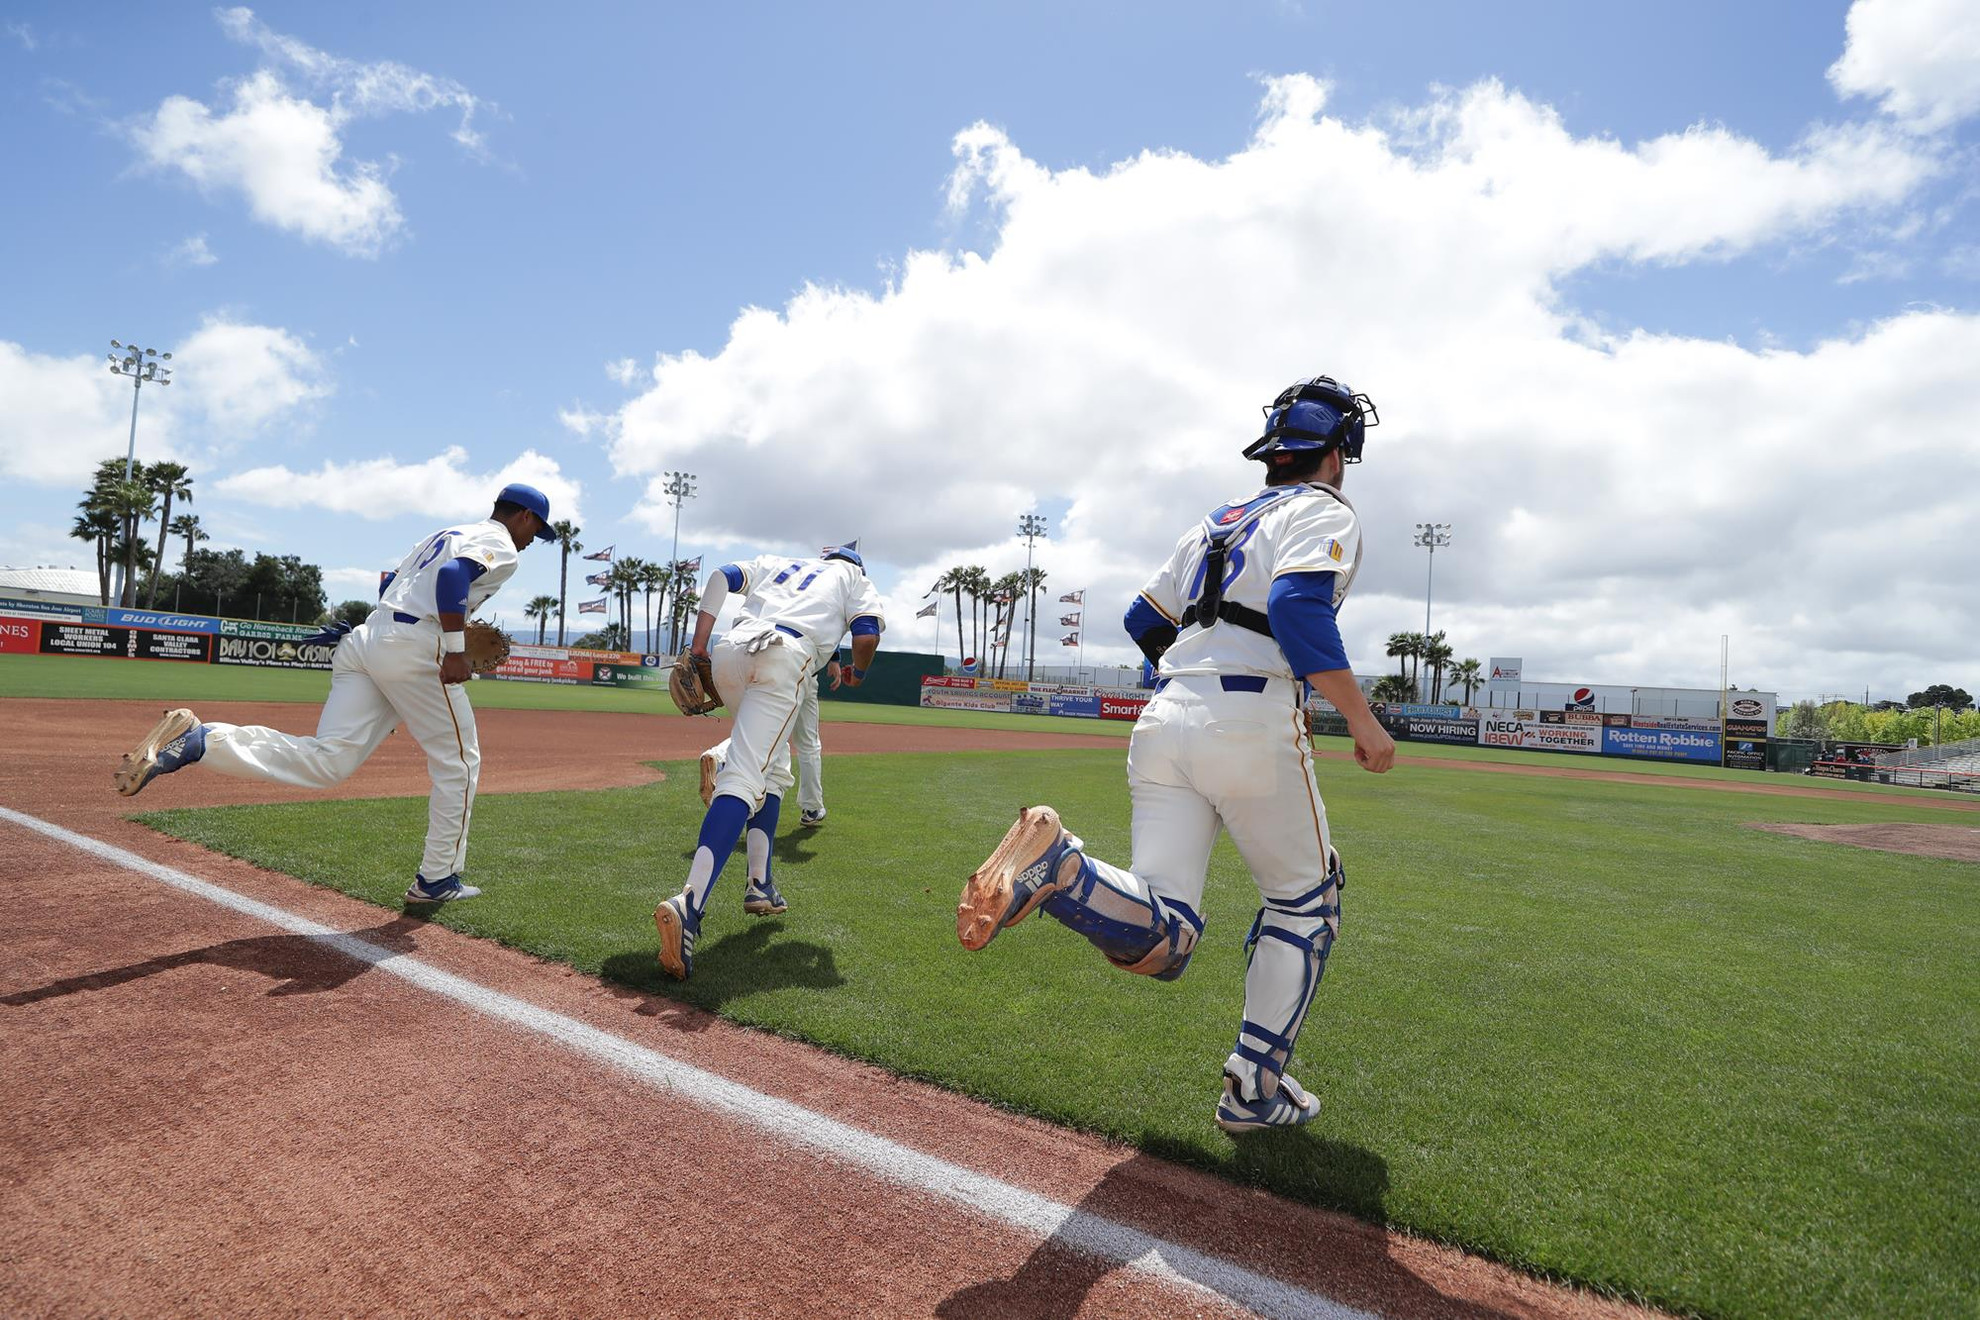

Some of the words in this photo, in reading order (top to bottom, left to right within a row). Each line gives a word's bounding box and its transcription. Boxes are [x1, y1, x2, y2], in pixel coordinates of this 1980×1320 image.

[773, 561, 825, 591] 11
[63, 606, 81, 614] Airport
[121, 613, 157, 624] BUD
[163, 617, 209, 628] LIGHT
[59, 626, 84, 634] SHEET
[85, 628, 109, 636] METAL
[240, 621, 252, 629] Go
[253, 623, 294, 633] Horseback
[64, 634, 103, 642] WORKERS
[150, 646, 201, 655] CONTRACTORS
[530, 659, 546, 667] FREE
[617, 672, 626, 680] We
[1119, 691, 1145, 700] LIGHT
[964, 700, 978, 708] Kids
[1568, 713, 1601, 721] BUBBA
[1410, 723, 1436, 733] NOW
[1438, 725, 1476, 736] HIRING
[1486, 721, 1524, 733] NECA
[1539, 729, 1587, 738] WORKING
[1609, 729, 1657, 743] Rotten
[1660, 733, 1714, 747] Robbie
[161, 737, 186, 752] adidas
[1539, 736, 1594, 746] TOGETHER
[1015, 861, 1048, 884] adidas
